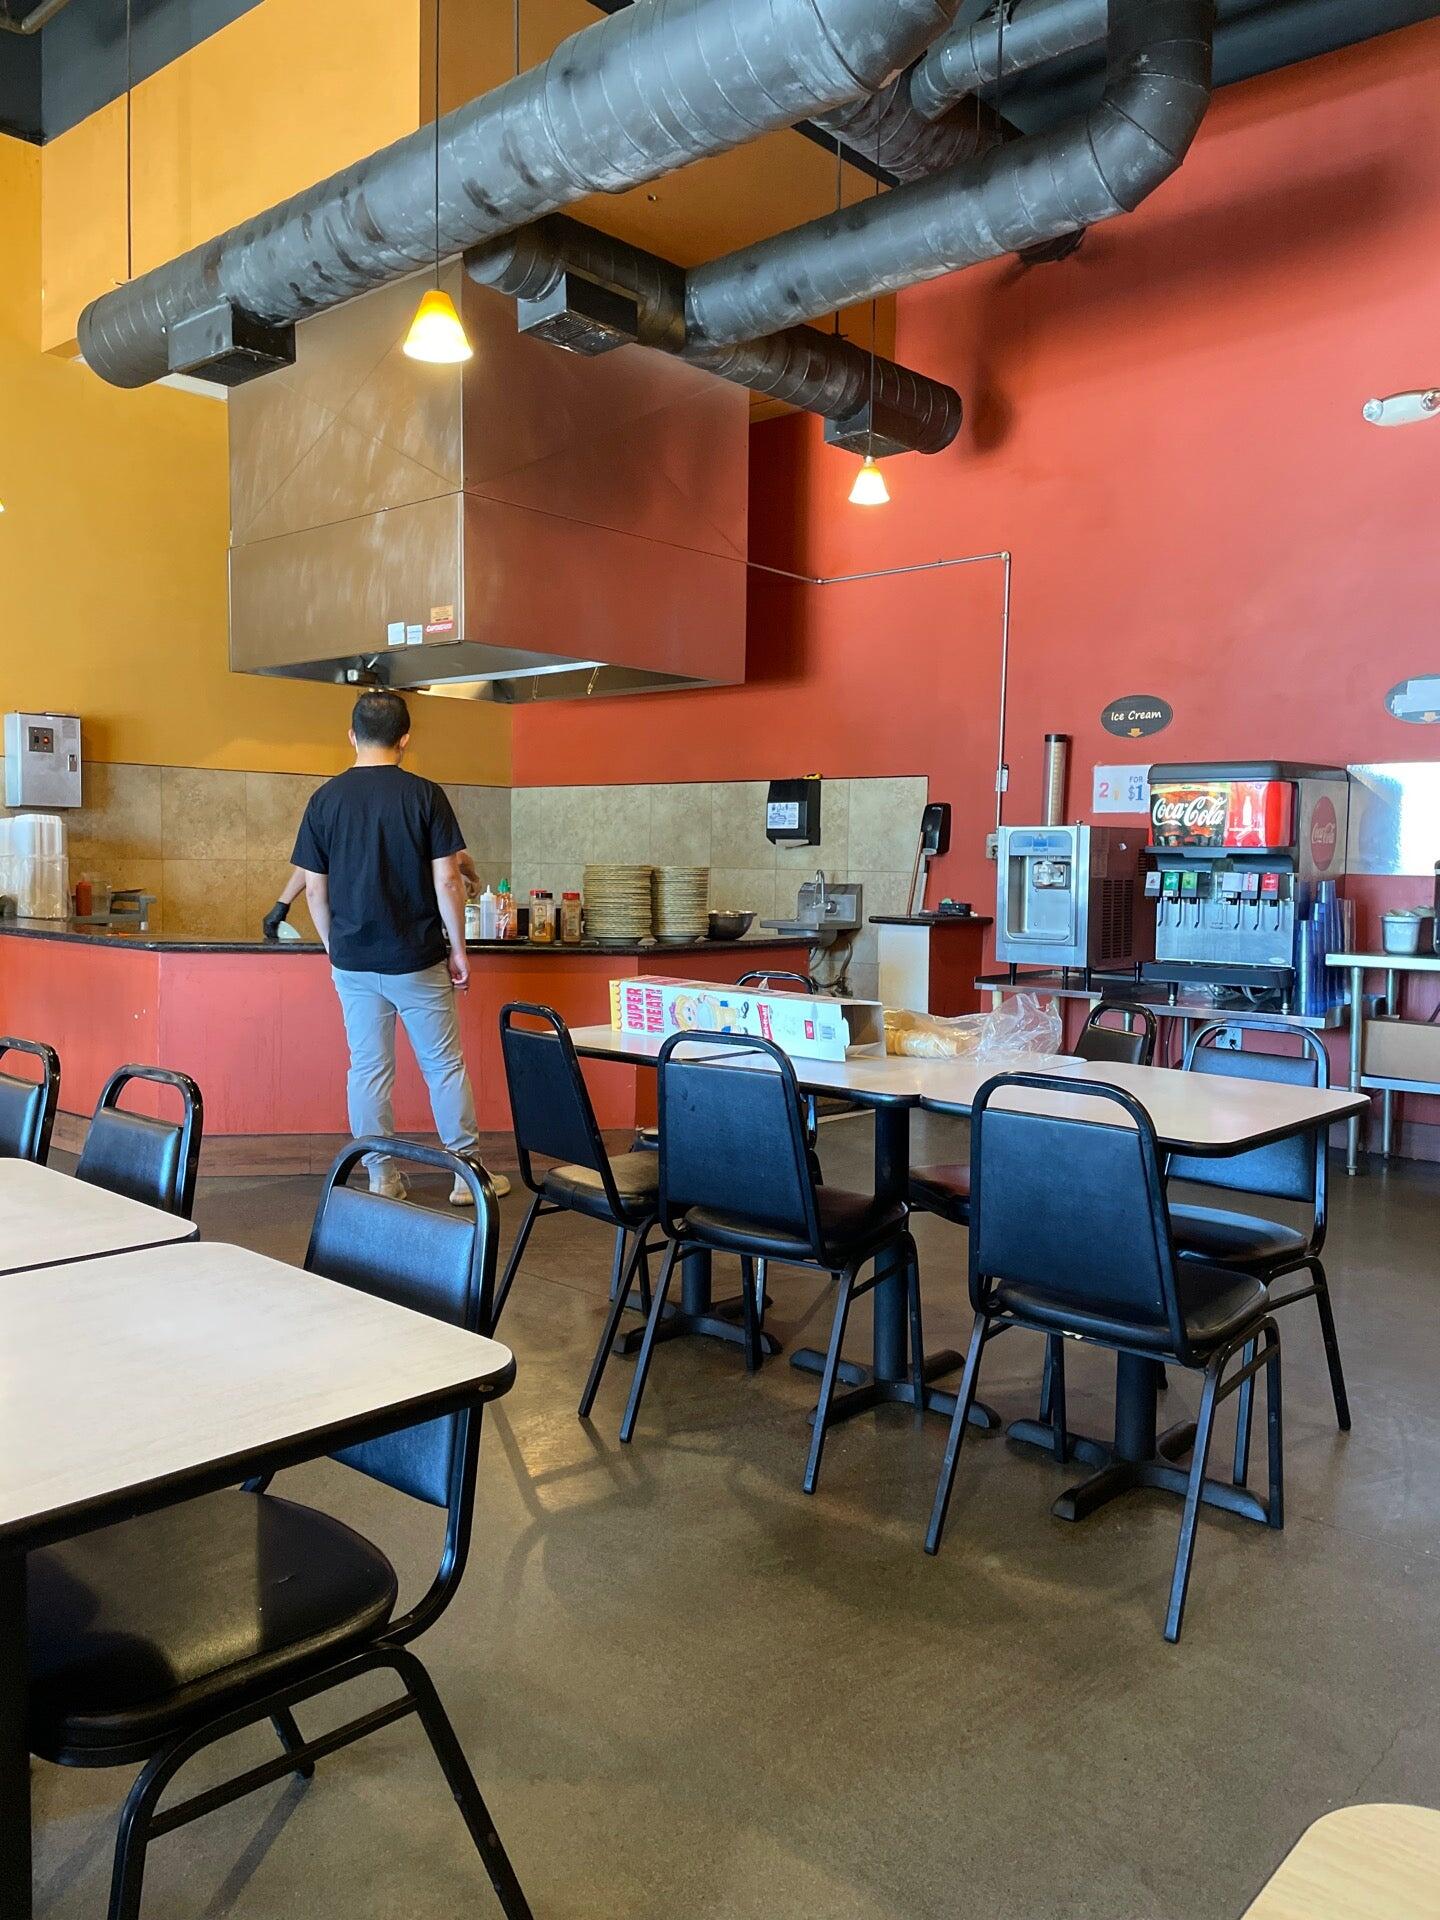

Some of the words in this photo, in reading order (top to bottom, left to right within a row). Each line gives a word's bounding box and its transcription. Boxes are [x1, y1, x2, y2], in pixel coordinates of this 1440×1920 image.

[1111, 711, 1125, 721] Ice
[1127, 710, 1162, 720] Cream
[1129, 775, 1144, 783] FOR
[1098, 782, 1110, 799] 2
[1128, 784, 1144, 801] $1
[626, 987, 645, 1030] SUPER
